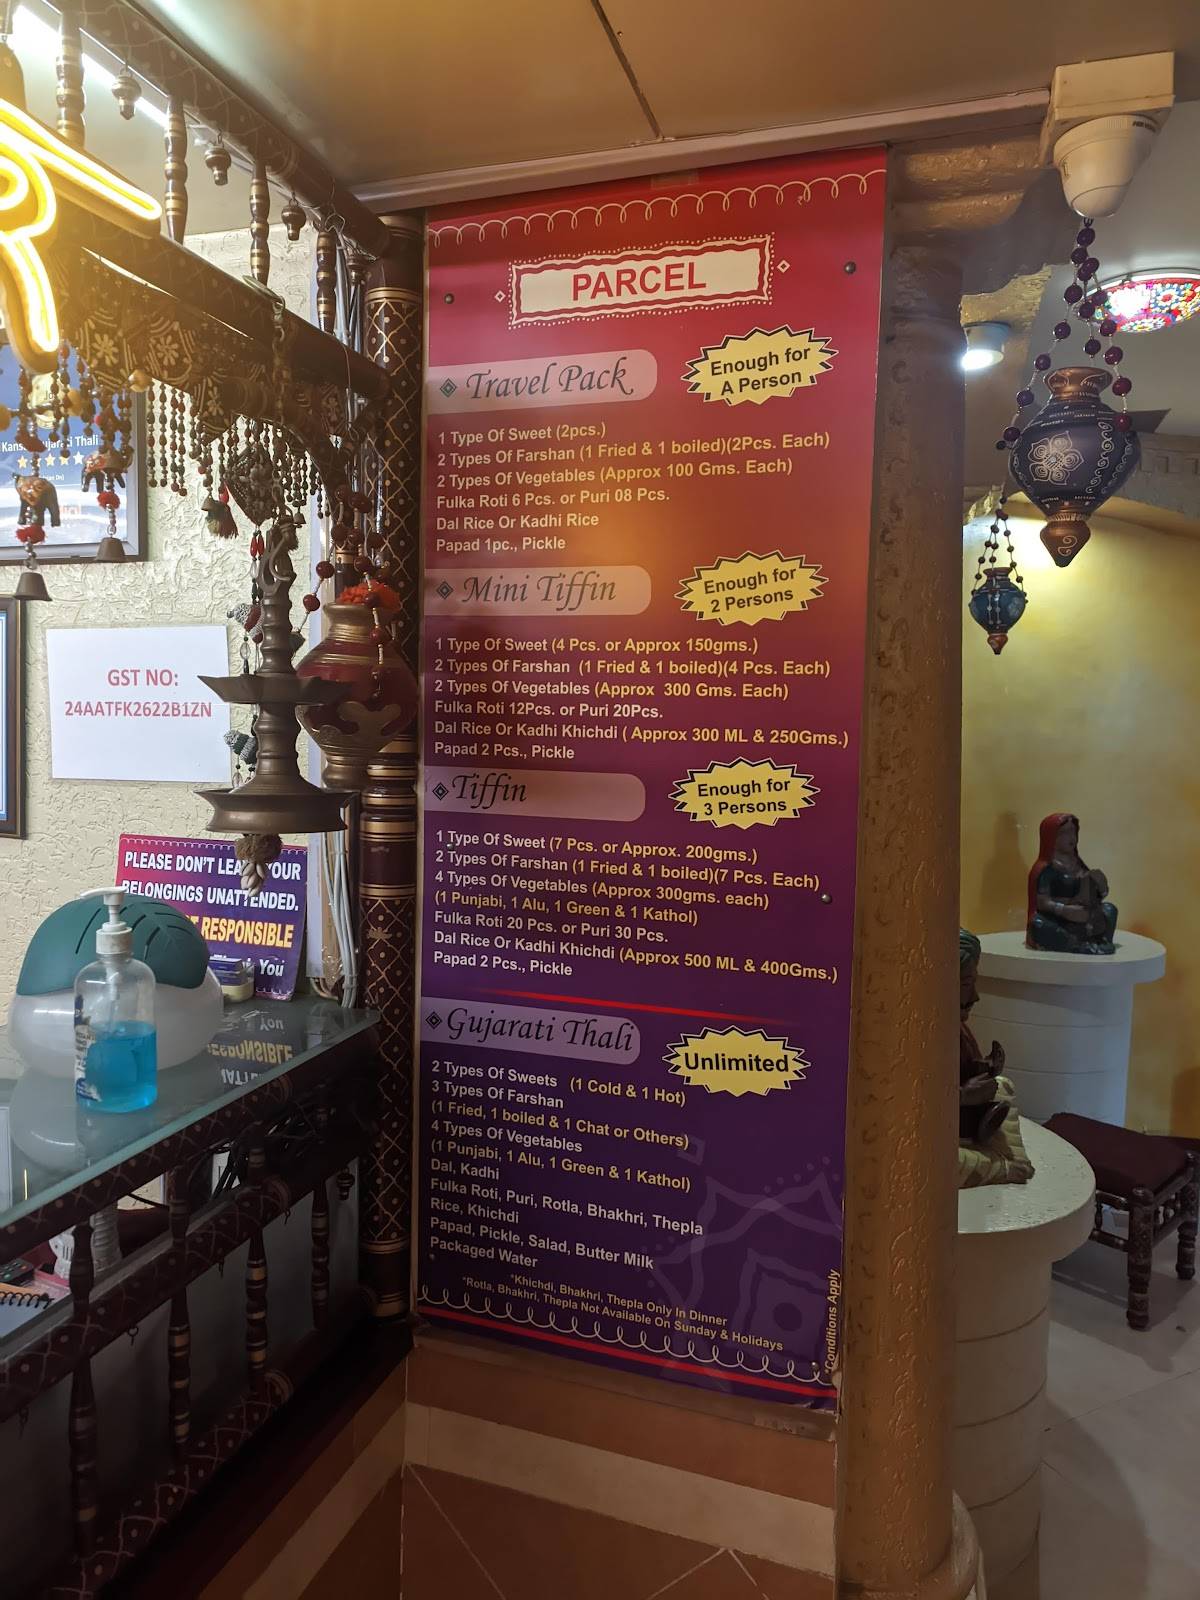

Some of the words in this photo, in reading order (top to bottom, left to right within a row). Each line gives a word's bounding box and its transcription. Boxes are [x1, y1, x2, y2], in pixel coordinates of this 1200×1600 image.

[572, 261, 706, 301] PARCEL
[711, 353, 779, 376] Enough
[784, 347, 811, 363] for
[465, 362, 556, 400] Travel
[558, 356, 634, 396] Pack
[720, 380, 734, 396] A
[738, 371, 802, 393] Person
[74, 435, 99, 447] Thali
[438, 431, 444, 445] 1
[450, 430, 484, 447] Type
[487, 427, 505, 442] Of
[508, 425, 552, 441] Sweet
[556, 421, 606, 441] (2pcs.)
[437, 453, 446, 466] 2
[449, 452, 491, 469] Types
[495, 449, 513, 464] Of
[516, 447, 575, 463] Farshan
[579, 444, 592, 462] (1
[598, 442, 636, 458] Fried
[641, 441, 652, 456] &
[658, 440, 664, 455] 1
[671, 436, 776, 456] boiled)(2Pcs.
[782, 431, 830, 449] Each)
[436, 474, 445, 488] 2
[448, 473, 491, 490] Types
[494, 471, 512, 485] Of
[515, 468, 595, 487] Vegetables
[600, 466, 661, 484] (Approx
[666, 462, 694, 477] 100
[698, 461, 740, 476] Gms.
[745, 457, 792, 476] Each)
[436, 495, 475, 509] Fulka
[479, 493, 508, 508] Roti
[511, 492, 520, 507] 6
[524, 492, 555, 506] Pcs.
[559, 494, 576, 504] or
[580, 488, 610, 503] Puri
[614, 488, 632, 502] 08
[637, 487, 670, 501] Pcs.
[436, 516, 459, 530] Dal
[463, 516, 494, 530] Rice
[498, 515, 516, 529] Or
[520, 513, 562, 528] Kadhi
[566, 512, 599, 527] Rice
[436, 537, 480, 555] Papad
[484, 537, 518, 554] 1pc.,
[522, 535, 566, 550] Pickle
[462, 574, 529, 603] Mini
[536, 571, 617, 611] Tiffin
[703, 571, 767, 595] Enough
[771, 567, 797, 584] for
[710, 599, 720, 613] 2
[724, 589, 794, 611] Persons
[436, 637, 441, 650] 1
[446, 637, 480, 654] Type
[484, 637, 502, 651] Of
[504, 637, 548, 652] Sweet
[551, 637, 565, 654] (4
[569, 637, 600, 651] Pcs.
[604, 641, 622, 651] or
[623, 637, 680, 655] Approx
[686, 637, 758, 655] 150gms.)
[107, 668, 139, 687] GST
[145, 668, 179, 687] NO:
[64, 700, 212, 718] 24AATFK2622B1ZN
[434, 699, 472, 713] Fulka
[476, 701, 504, 714] Roti
[508, 701, 555, 716] 12Pcs.
[559, 705, 575, 716] or
[579, 703, 609, 717] Puri
[612, 703, 663, 718] 20Pcs.
[434, 721, 456, 734] Dal
[461, 721, 491, 735] Rice
[495, 722, 513, 735] Or
[516, 723, 557, 737] Kadhi
[562, 723, 618, 739] Khichdi
[622, 725, 627, 743] (
[630, 726, 687, 743] Approx
[691, 727, 719, 742] 300
[724, 728, 748, 743] ML
[752, 728, 765, 743] &
[769, 729, 848, 749] 250Gms.)
[451, 772, 527, 810] Tiffin
[697, 779, 761, 797] Enough
[766, 778, 790, 792] for
[704, 802, 713, 816] 3
[718, 800, 787, 815] Persons
[436, 829, 442, 842] 1
[446, 830, 479, 847] Type
[482, 832, 500, 846] Of
[502, 833, 546, 849] Sweet
[549, 836, 562, 853] (7
[567, 837, 598, 852] Pcs.
[602, 843, 618, 853] or
[620, 841, 680, 858] Approx.
[685, 844, 757, 865] 200gms.)
[125, 851, 172, 870] PLEASE
[175, 855, 215, 874] DON'T
[122, 880, 203, 903] BELONGINGS
[434, 889, 446, 906] (1
[451, 891, 506, 910] Punjabi,
[511, 896, 517, 909] 1
[521, 897, 549, 914] Alu,
[554, 899, 560, 912] 1
[566, 900, 610, 916] Green
[614, 904, 626, 918] &
[630, 905, 636, 918] 1
[643, 906, 698, 927] Kathol)
[201, 916, 294, 948] RESPONSIBLE
[259, 959, 285, 977] You
[446, 1007, 556, 1043] Gujarati
[562, 1018, 634, 1051] Thali
[683, 1052, 790, 1074] Unlimited
[431, 1178, 466, 1194] Fulka
[471, 1183, 501, 1202] Roti,
[506, 1189, 538, 1209] Puri,
[542, 1195, 582, 1216] Rotla,
[587, 1202, 647, 1228] Bhakhri,
[652, 1214, 703, 1235] Thepla
[430, 1216, 475, 1236] Papad,
[479, 1224, 524, 1246] Pickle,
[528, 1234, 570, 1256] Salad,
[575, 1242, 620, 1262] Butter
[624, 1251, 654, 1269] Milk
[430, 1235, 494, 1259] Packaged
[498, 1247, 538, 1268] Water
[827, 1268, 841, 1304] Apply
[497, 1283, 540, 1302] Bhakhri,
[542, 1293, 578, 1310] Thepla
[580, 1301, 600, 1314] Not
[601, 1305, 652, 1325] Available
[654, 1316, 670, 1329] On
[673, 1319, 717, 1340] Sunday
[719, 1328, 728, 1340] &
[732, 1330, 783, 1352] Holidays
[559, 1283, 603, 1303] Bhakhri,
[606, 1292, 643, 1310] Thepla
[646, 1301, 672, 1318] Only
[675, 1306, 686, 1319] In
[686, 1309, 728, 1326] Dinner
